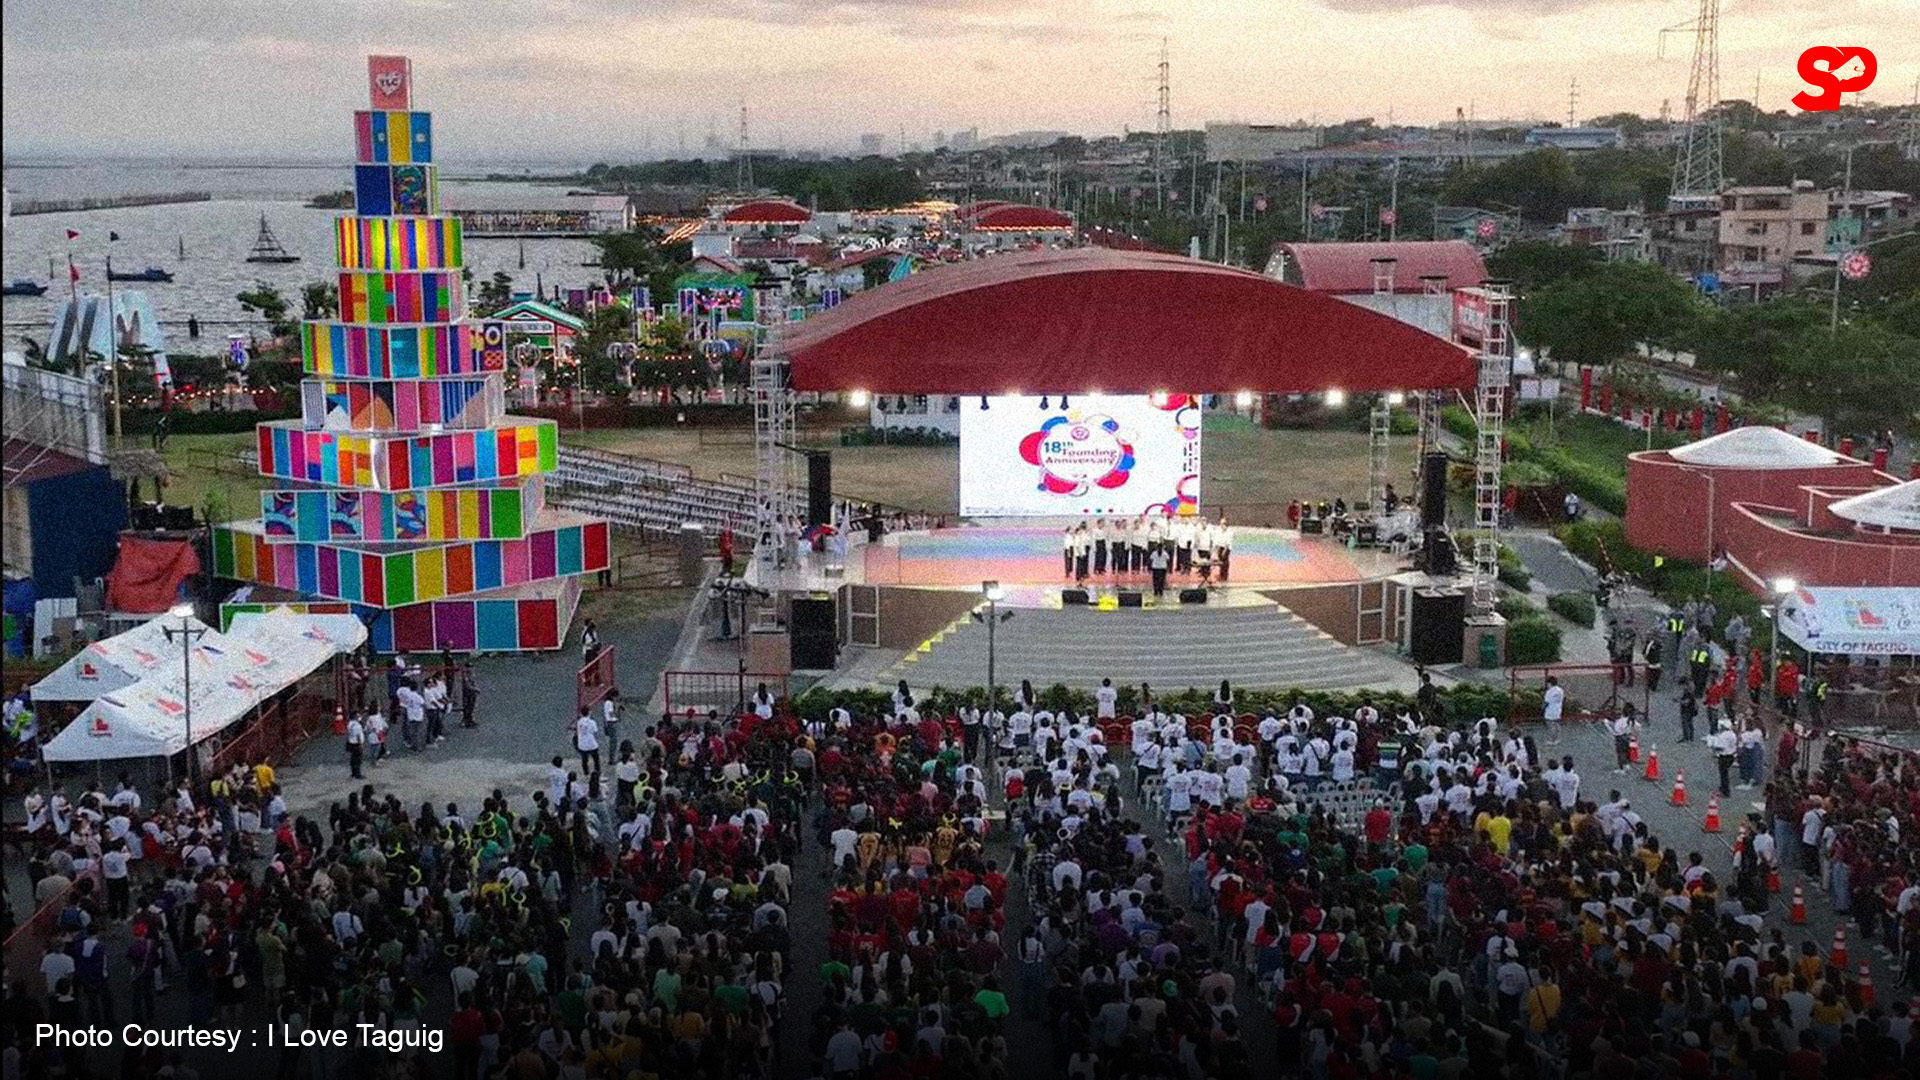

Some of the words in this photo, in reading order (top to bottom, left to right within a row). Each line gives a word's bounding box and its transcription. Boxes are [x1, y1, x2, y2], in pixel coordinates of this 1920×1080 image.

[1062, 448, 1117, 458] Founding
[1045, 456, 1116, 466] Anniversary
[1816, 641, 1840, 652] CITY
[1841, 641, 1858, 652] OF
